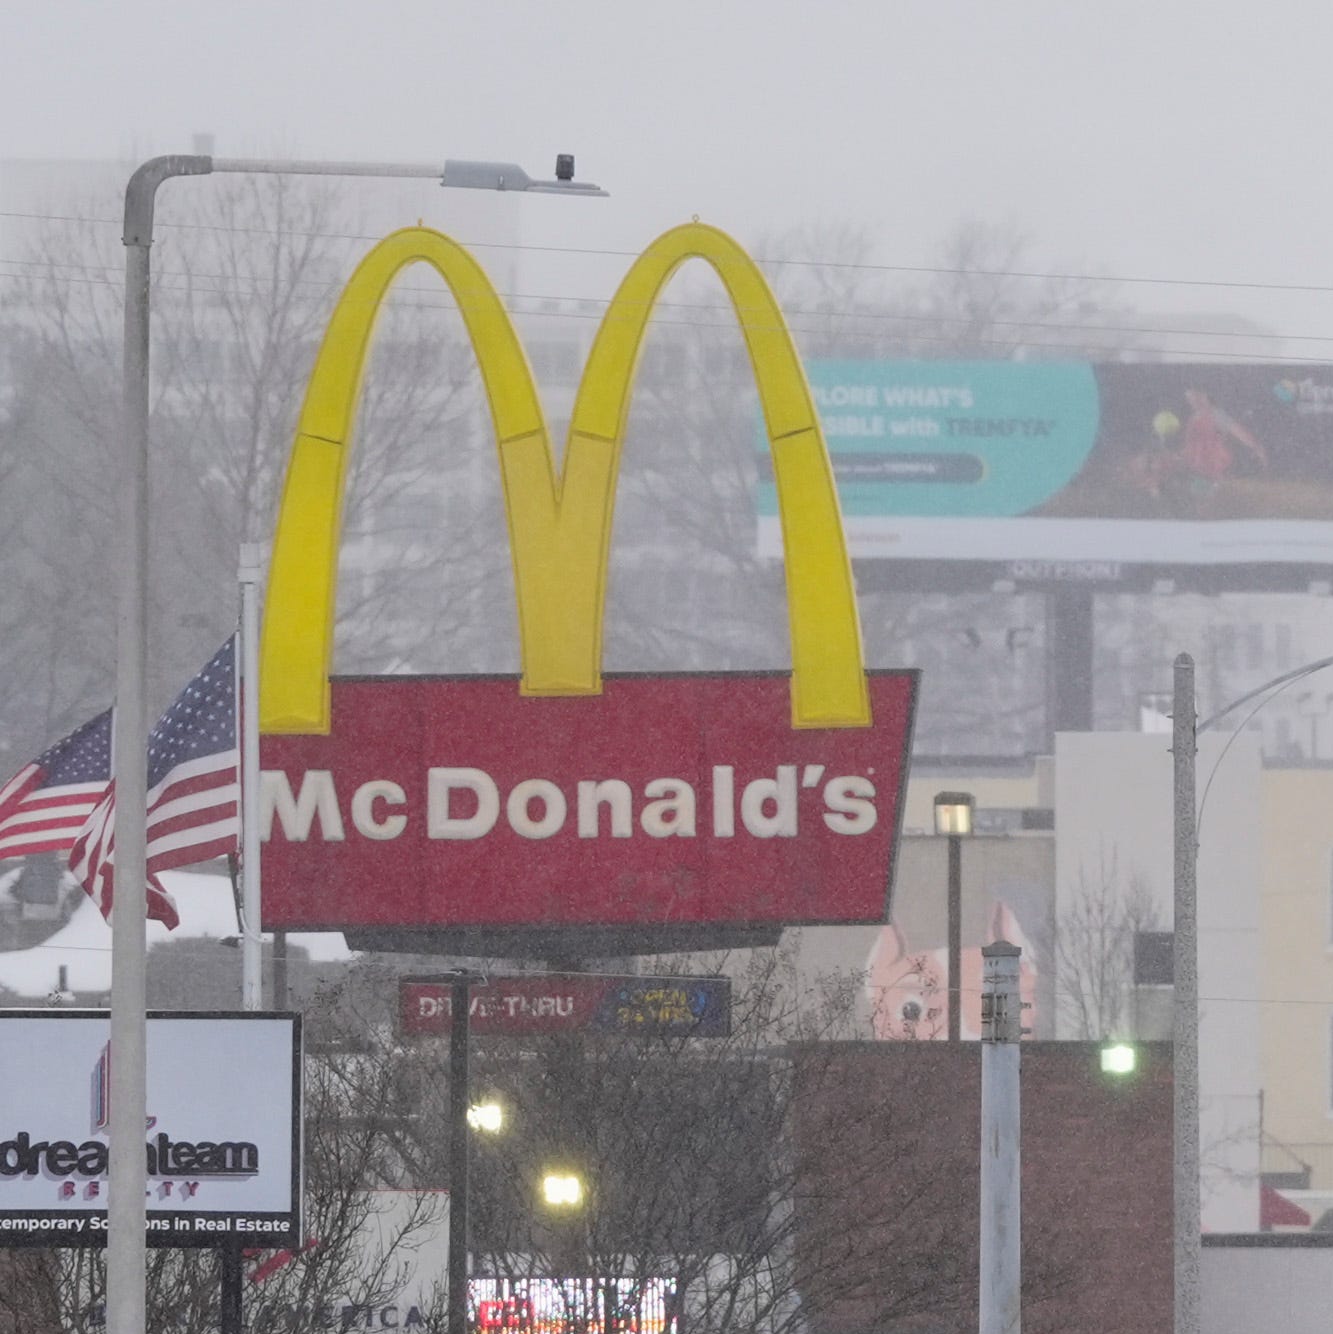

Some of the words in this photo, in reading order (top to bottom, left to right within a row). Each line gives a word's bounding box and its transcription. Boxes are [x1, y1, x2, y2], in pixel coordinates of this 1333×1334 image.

[813, 386, 878, 406] LORE
[825, 415, 884, 435] SIBLE
[260, 766, 878, 842] McDonald's
[418, 996, 574, 1018] DRVE-THRU
[0, 1132, 258, 1176] dreateam
[63, 1181, 199, 1197] RETY
[0, 1218, 85, 1232] emporary
[174, 1217, 190, 1231] in
[195, 1218, 231, 1231] Real
[235, 1219, 290, 1232] Estate
